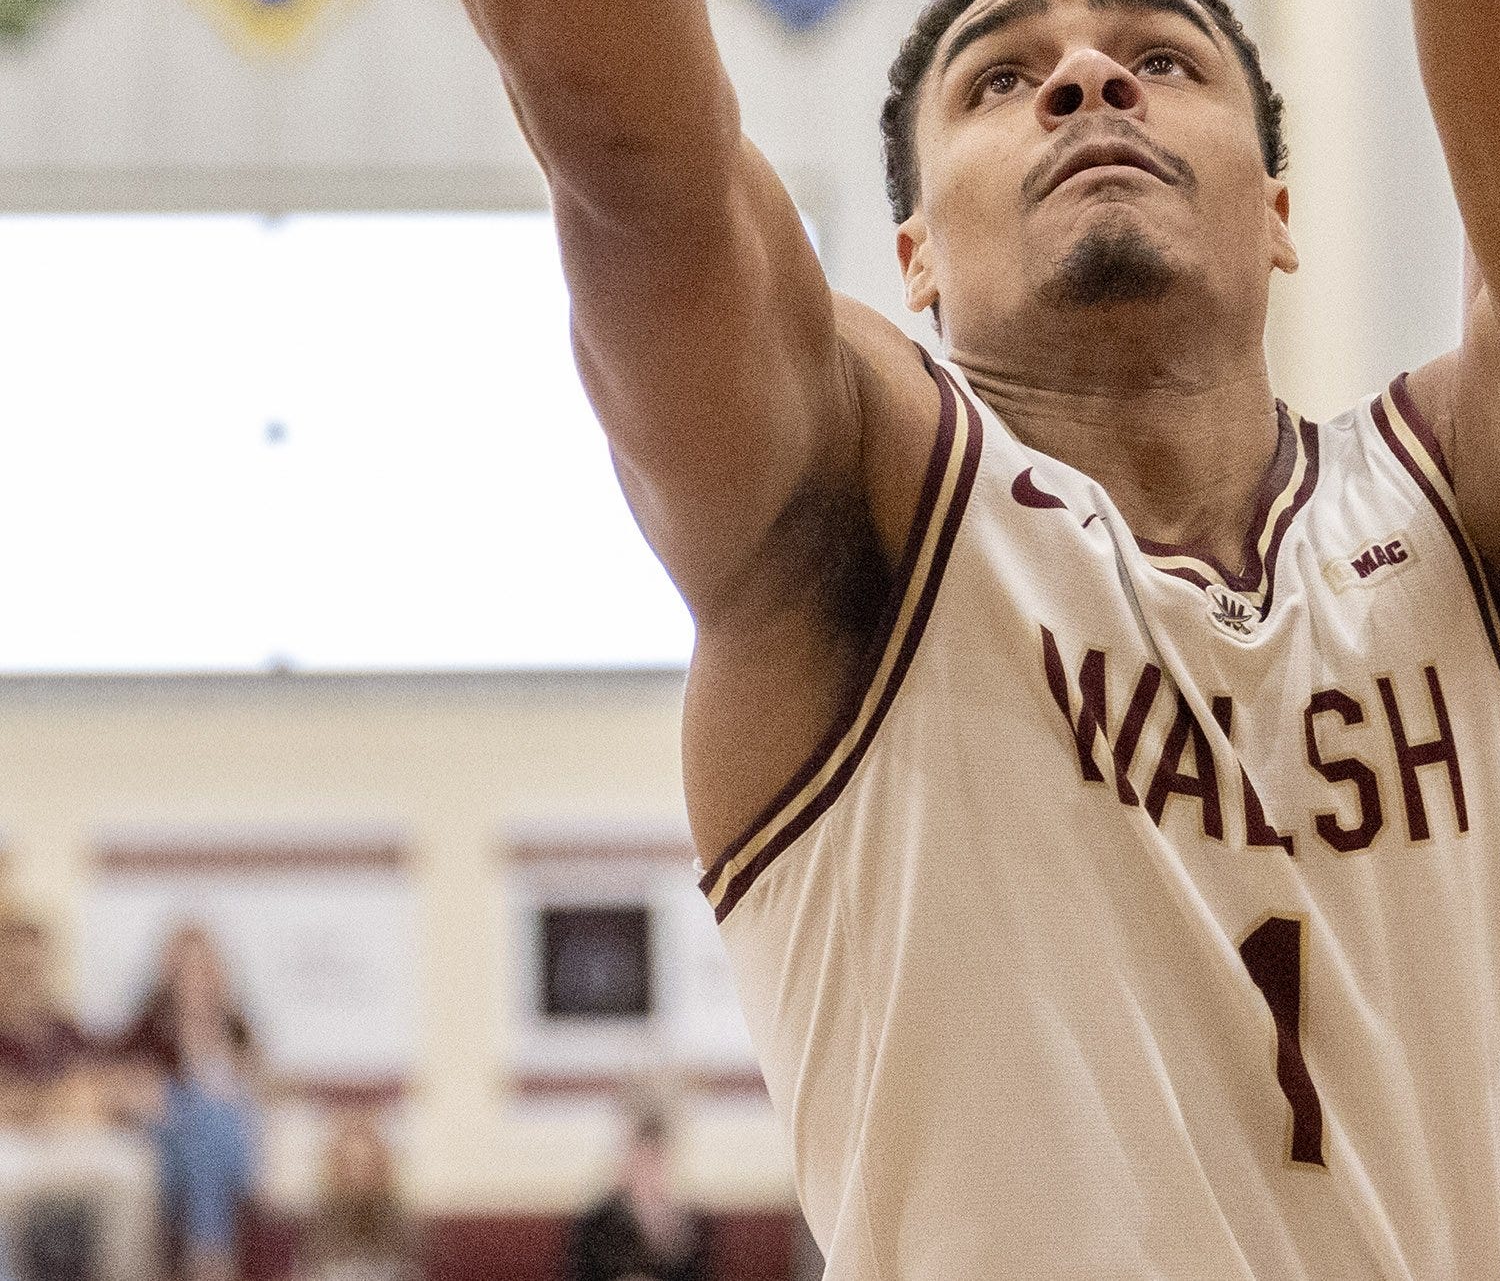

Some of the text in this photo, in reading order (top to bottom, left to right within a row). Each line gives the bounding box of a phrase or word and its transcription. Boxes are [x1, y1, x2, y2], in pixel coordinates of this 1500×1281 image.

[1351, 540, 1409, 579] MAC
[1039, 623, 1470, 857] WALSH
[1237, 915, 1328, 1170] 1
